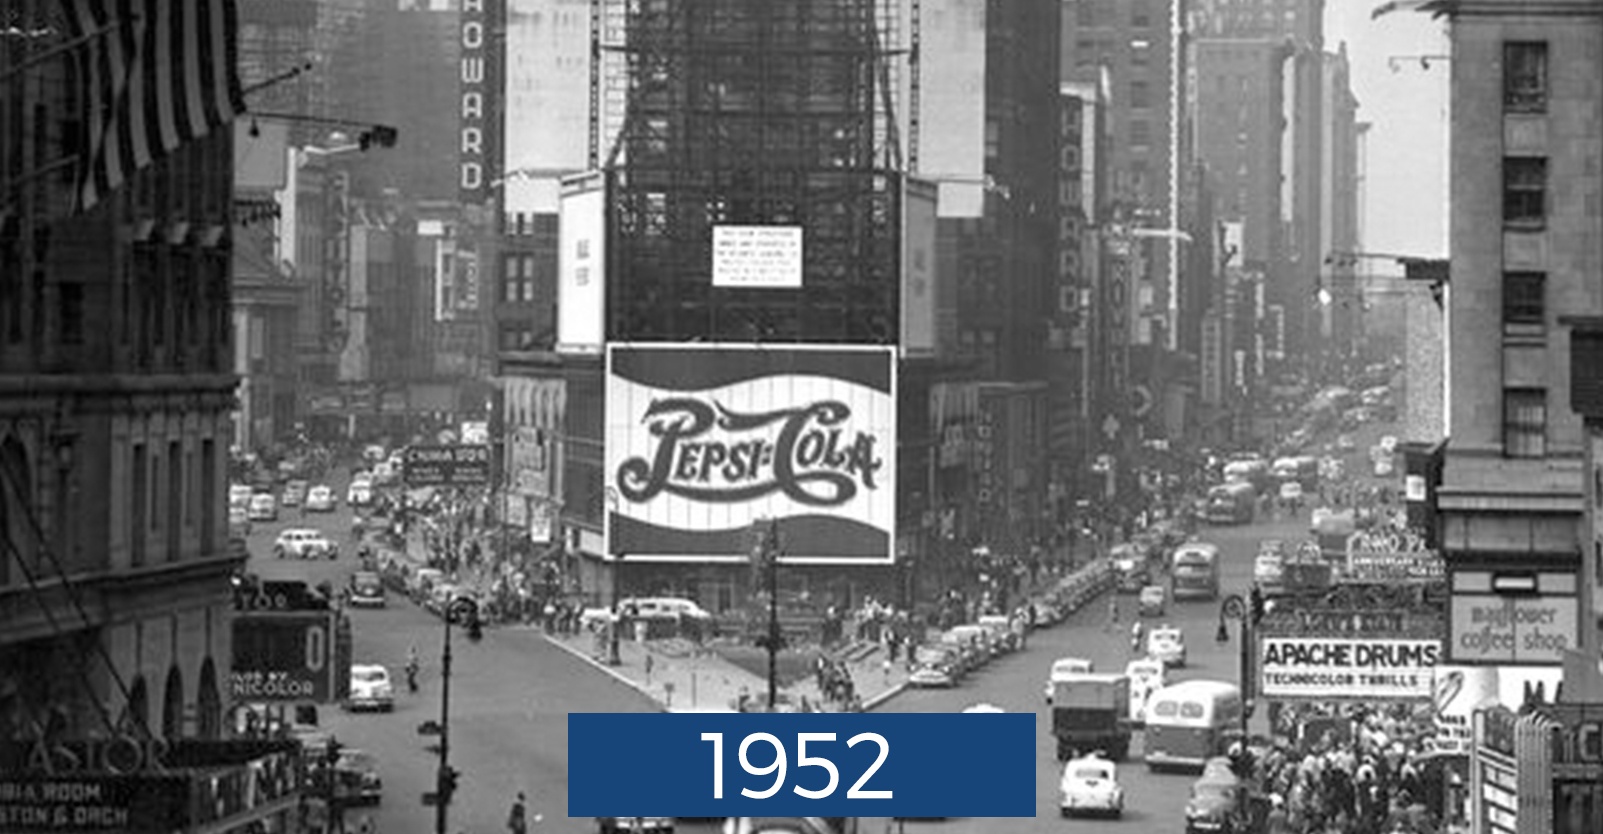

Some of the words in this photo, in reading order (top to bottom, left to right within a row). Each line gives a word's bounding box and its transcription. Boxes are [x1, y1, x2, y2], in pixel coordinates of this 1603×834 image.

[1060, 109, 1081, 312] HOWARD
[1523, 626, 1567, 655] shop
[1264, 643, 1351, 666] APACHE
[1356, 644, 1438, 667] DRUMS
[1264, 672, 1354, 686] TECHNICOLOR
[1359, 674, 1419, 687] THRILLS
[28, 728, 170, 776] ASTOR
[73, 805, 128, 826] ORCH
